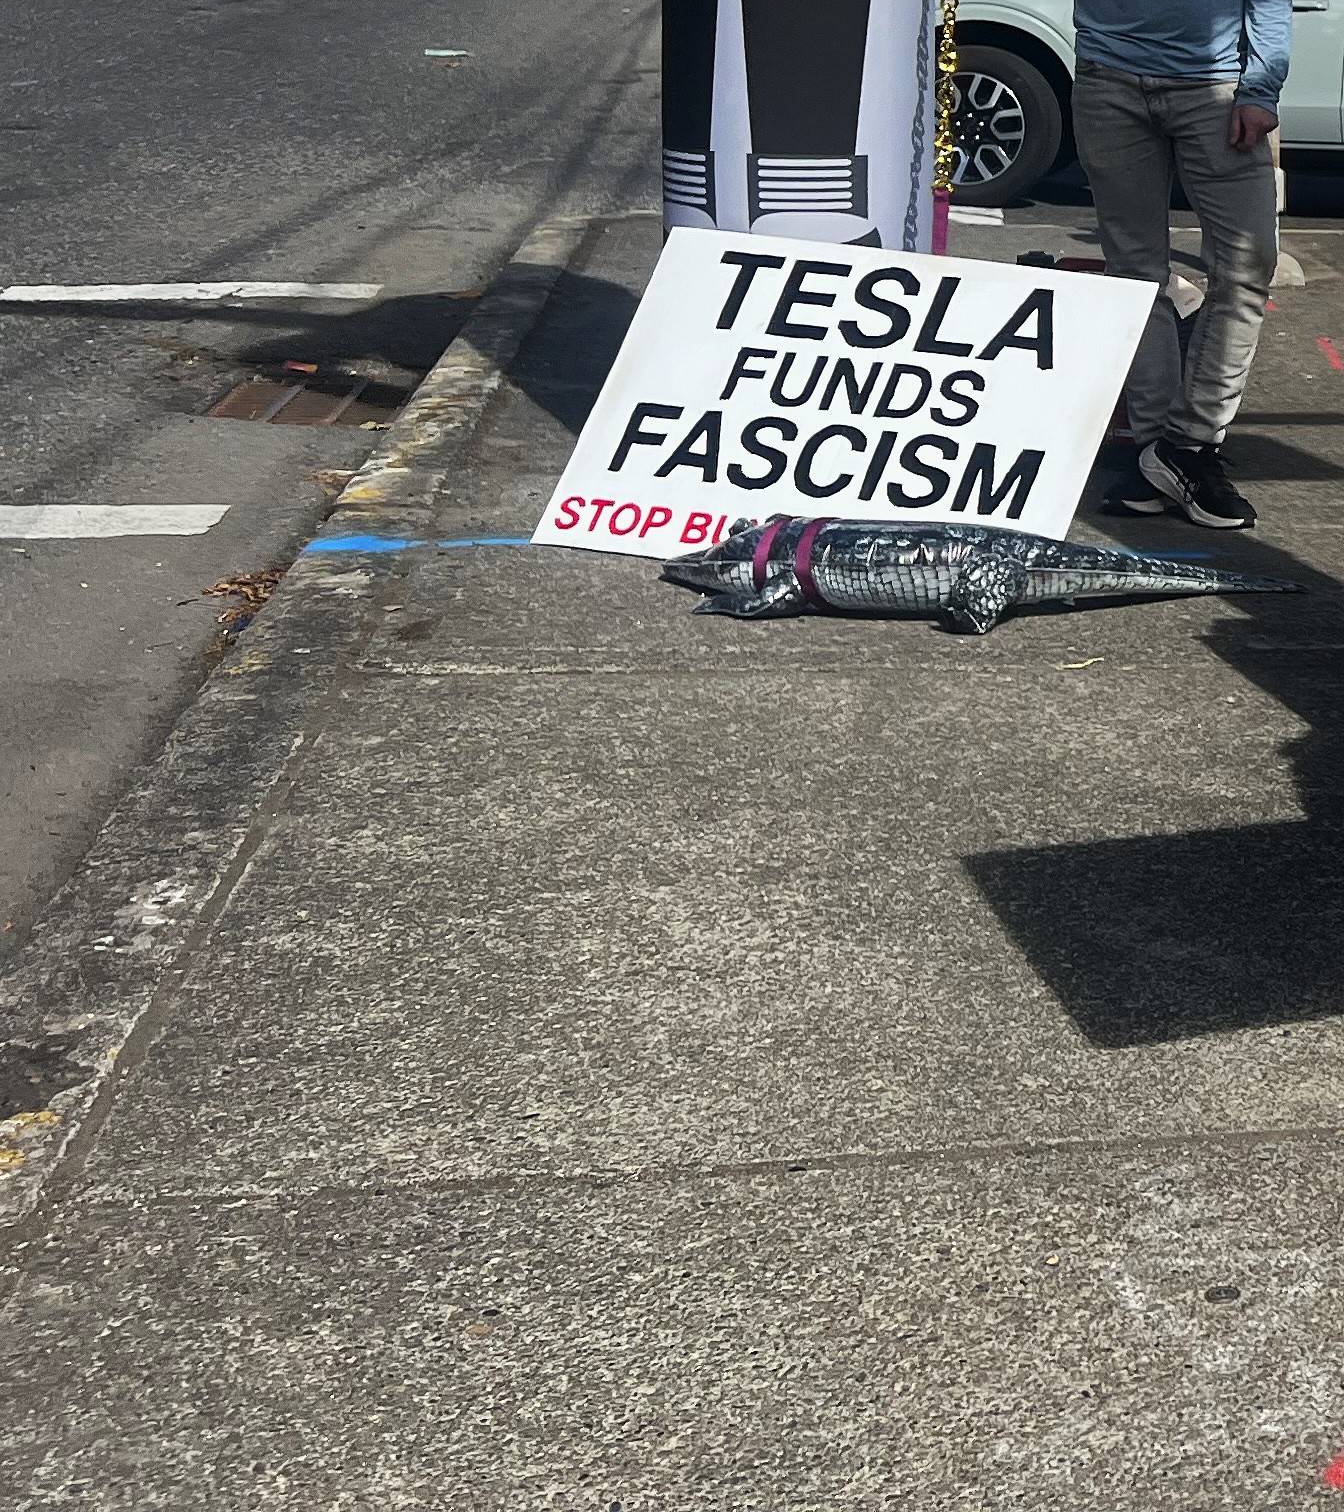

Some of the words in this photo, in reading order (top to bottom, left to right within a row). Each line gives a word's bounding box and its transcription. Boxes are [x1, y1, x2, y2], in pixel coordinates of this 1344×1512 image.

[715, 251, 1056, 371] TESLA
[719, 348, 985, 428] FUNDS
[607, 402, 1044, 520] FASCISM
[554, 496, 673, 538] STOP
